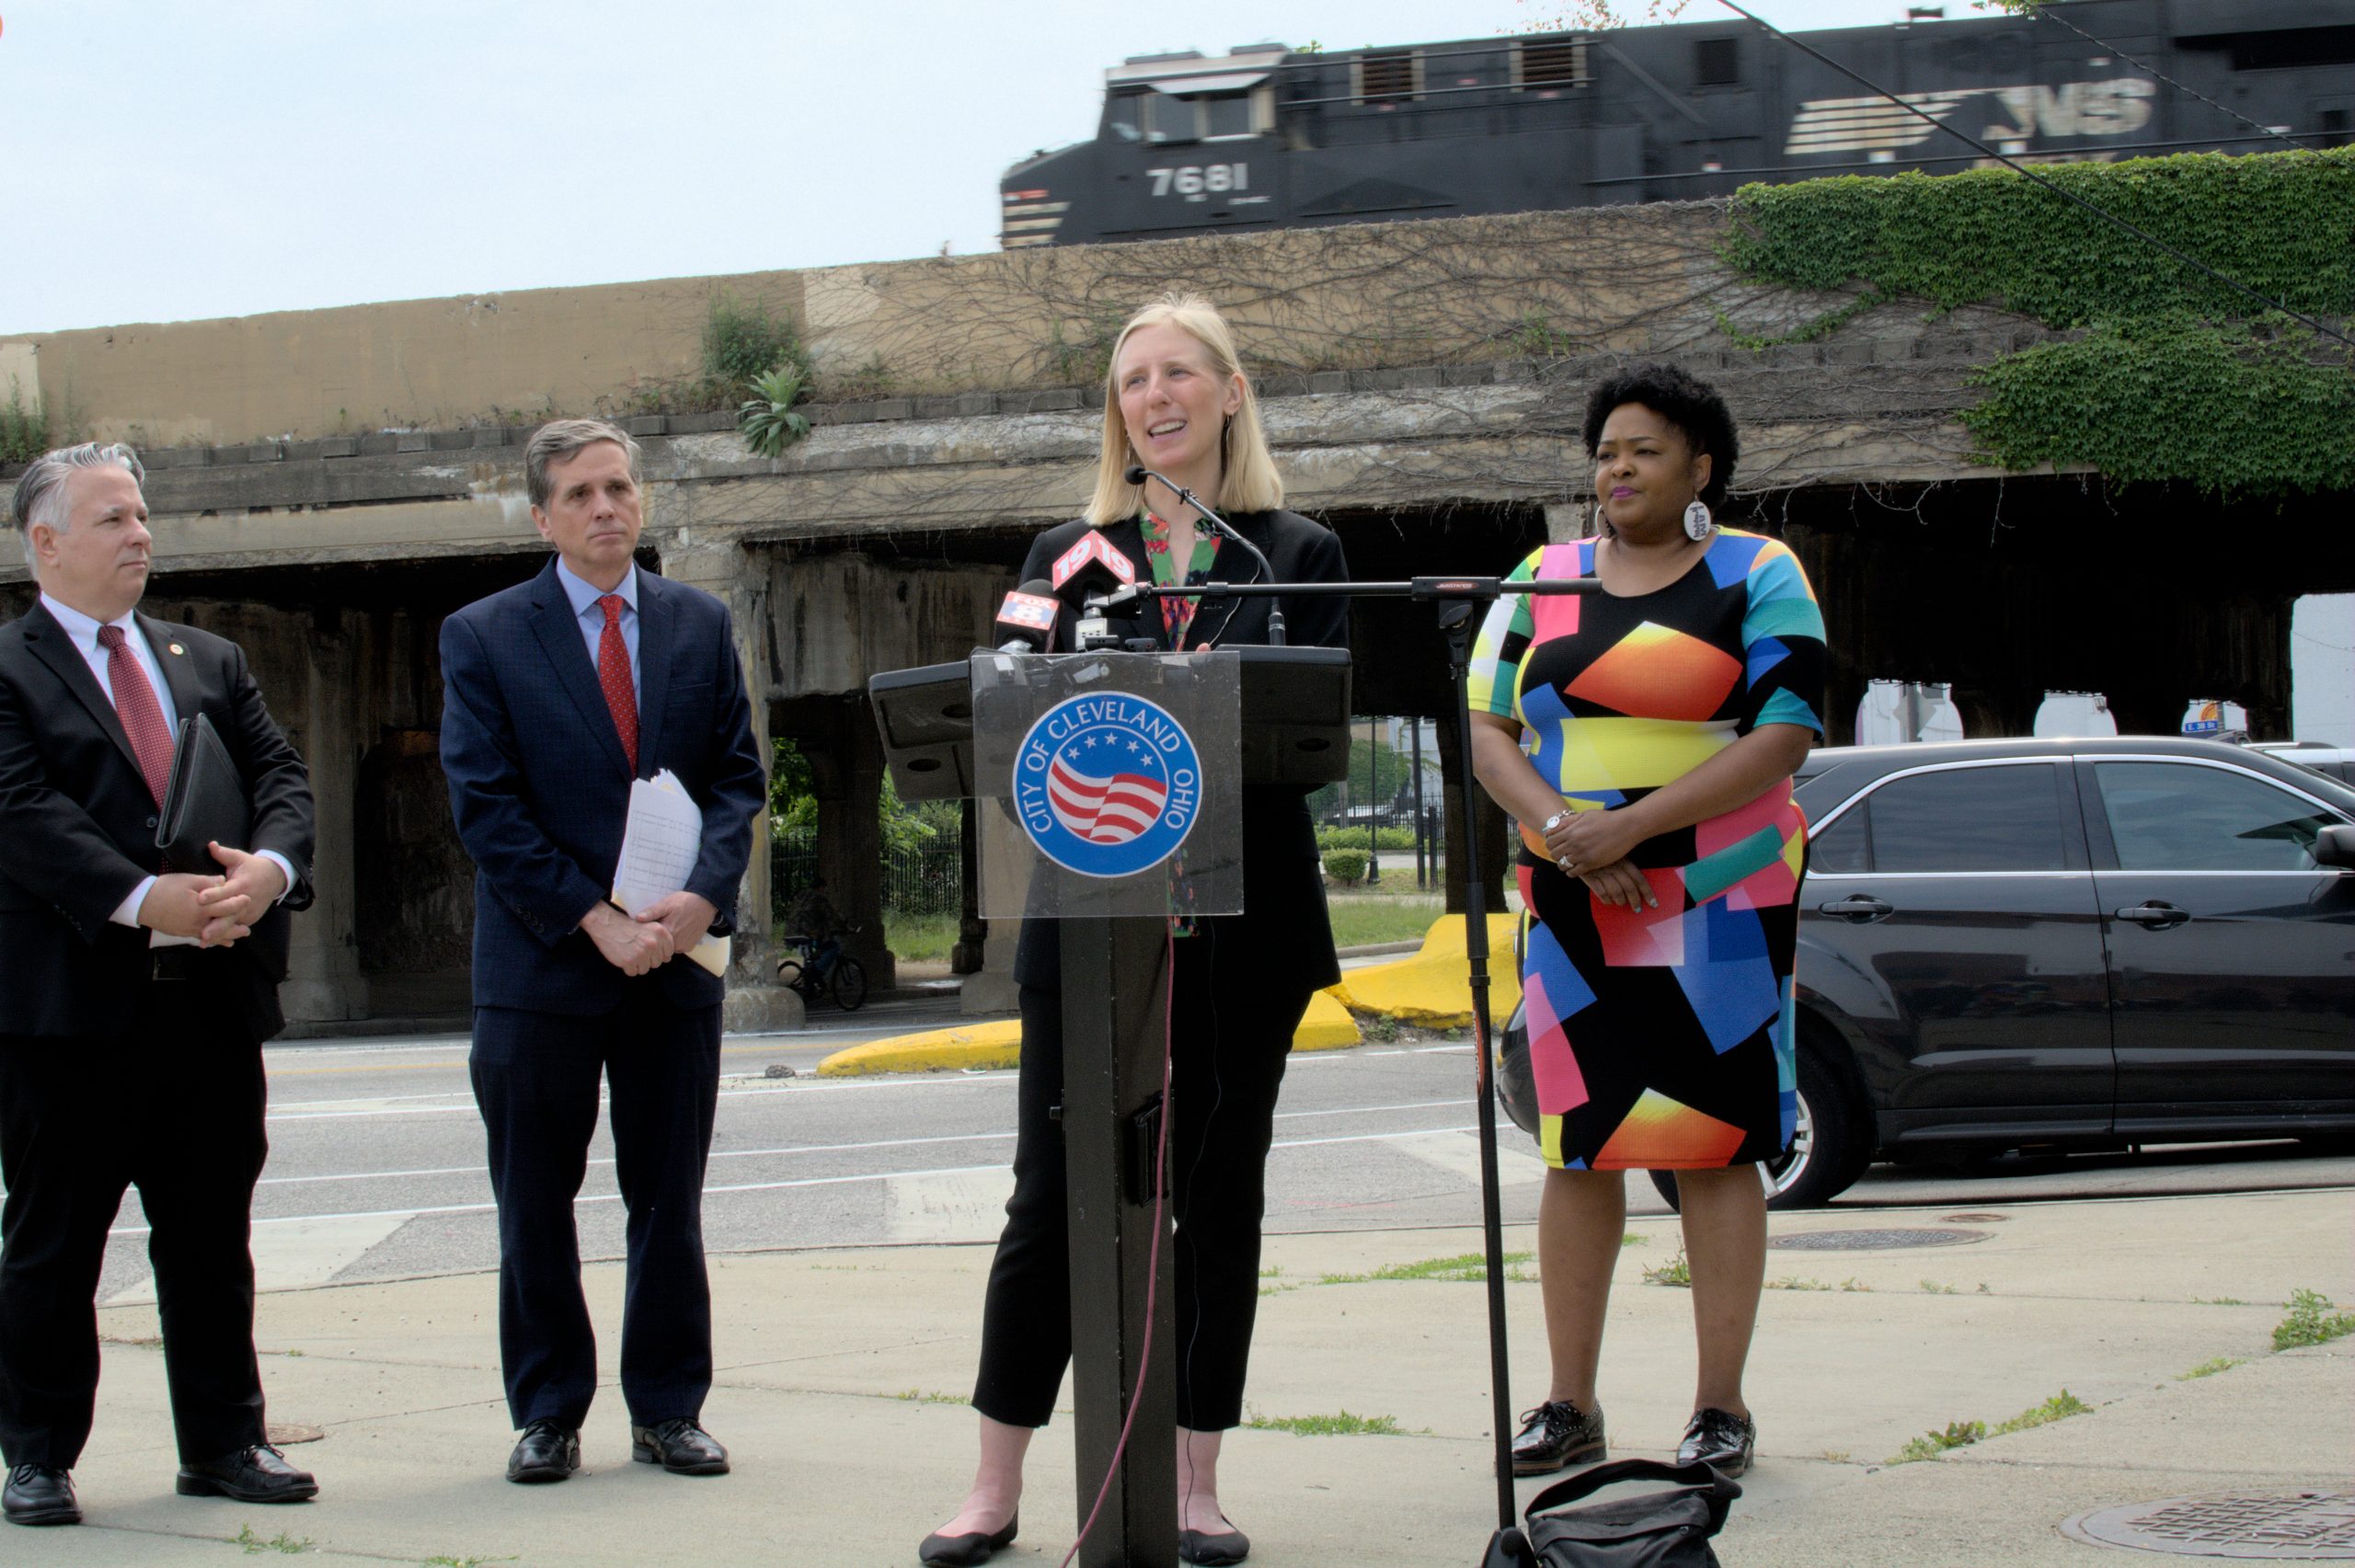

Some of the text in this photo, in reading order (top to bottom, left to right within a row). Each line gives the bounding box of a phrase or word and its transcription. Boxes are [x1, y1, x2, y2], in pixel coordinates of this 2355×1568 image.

[1145, 163, 1248, 196] 7681
[1057, 539, 1091, 580] 19
[1097, 538, 1132, 578] 19
[1012, 603, 1042, 622] 8
[1013, 594, 1052, 609] FOX
[1022, 701, 1194, 832] CITY OF CLEVELAND OHIO
